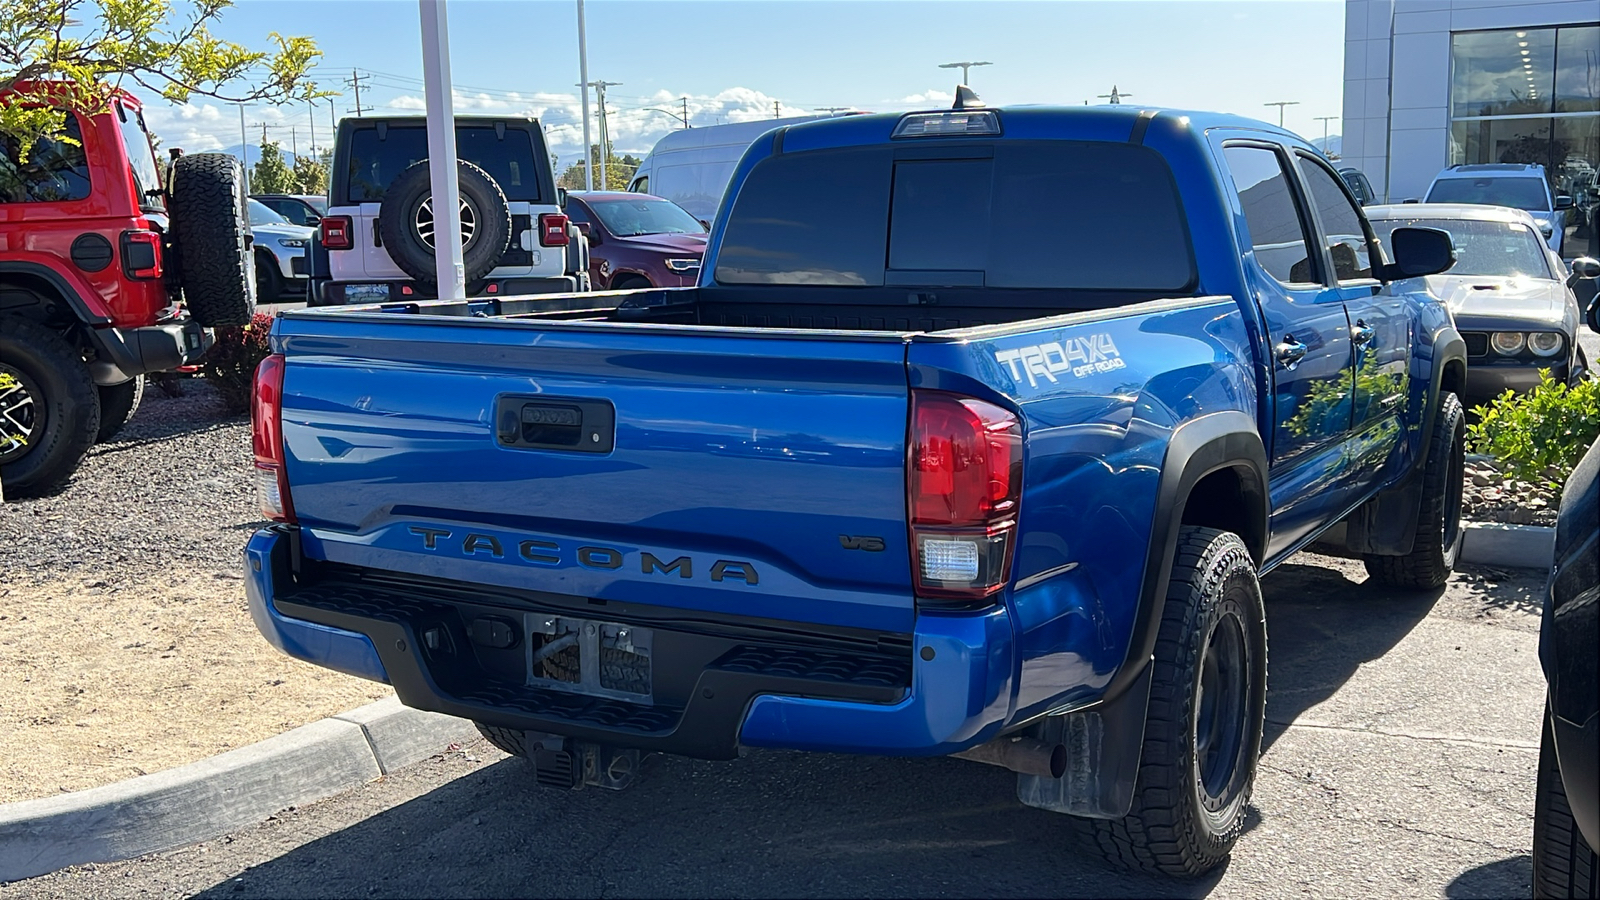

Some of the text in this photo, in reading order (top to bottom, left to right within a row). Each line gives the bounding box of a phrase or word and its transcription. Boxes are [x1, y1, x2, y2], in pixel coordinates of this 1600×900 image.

[995, 341, 1072, 388] TRD
[1073, 357, 1126, 378] OFF ROAD
[407, 526, 760, 586] TACOMA
[839, 534, 886, 552] V6
